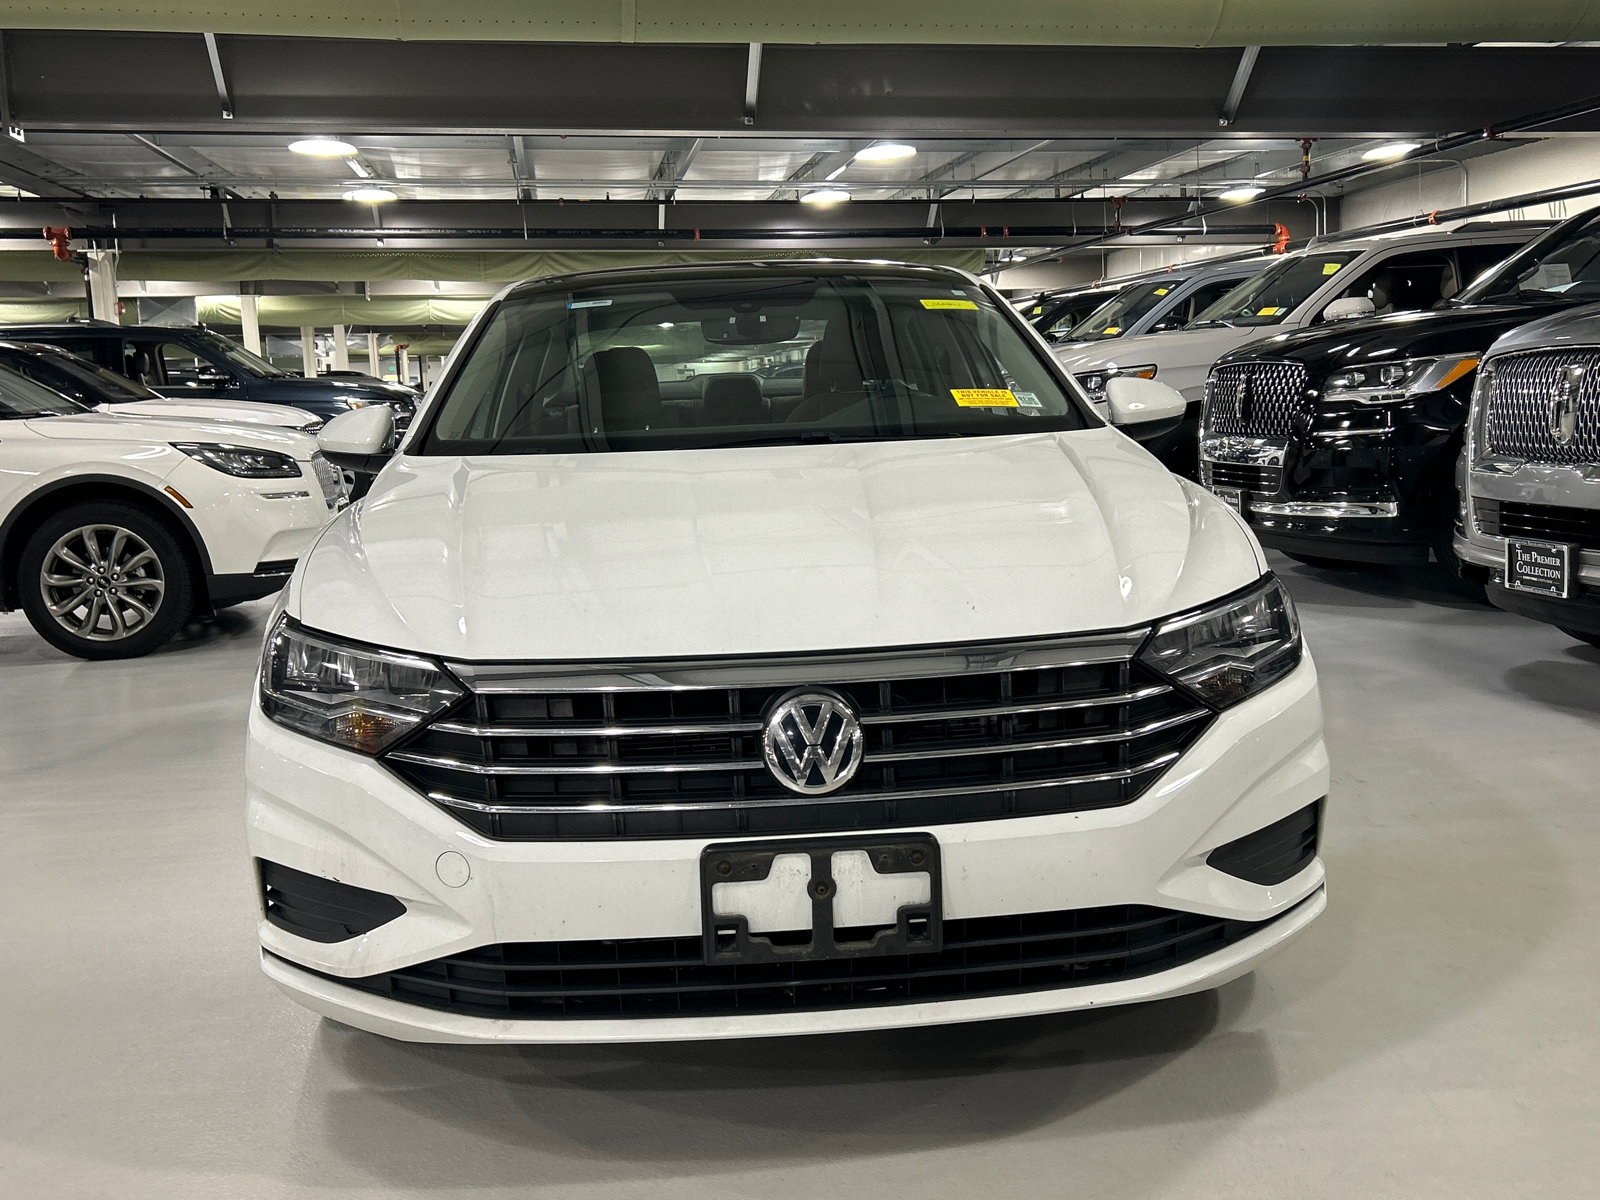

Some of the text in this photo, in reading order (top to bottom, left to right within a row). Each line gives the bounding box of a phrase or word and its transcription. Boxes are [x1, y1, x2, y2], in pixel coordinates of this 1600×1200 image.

[1516, 550, 1560, 566] THE PREMIER
[1516, 561, 1560, 579] COLLECTION
